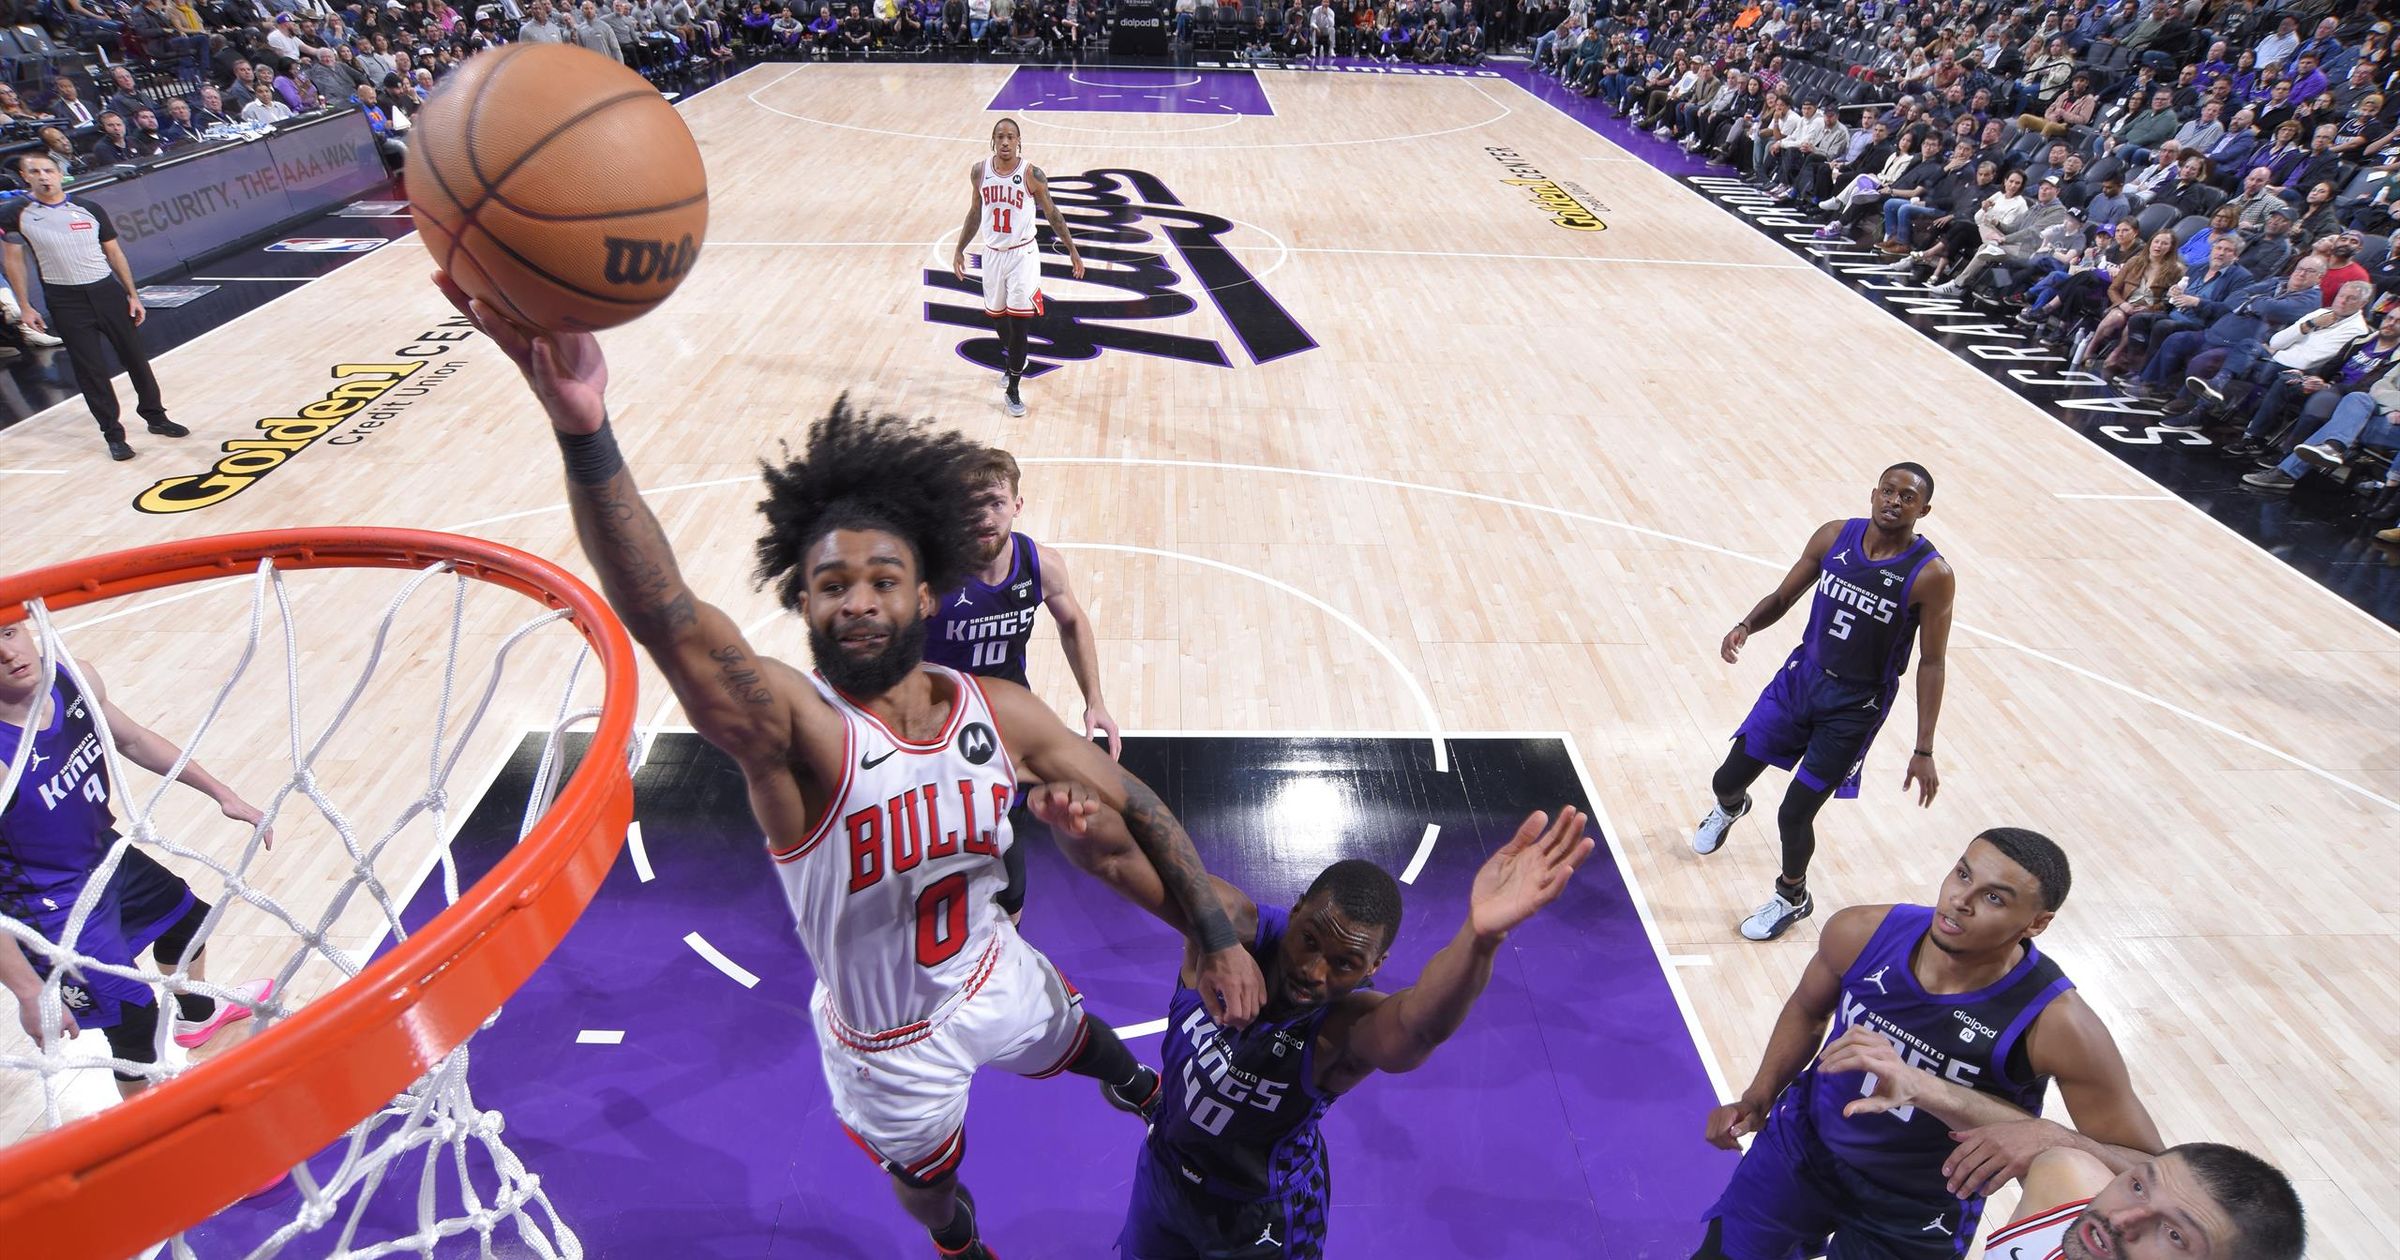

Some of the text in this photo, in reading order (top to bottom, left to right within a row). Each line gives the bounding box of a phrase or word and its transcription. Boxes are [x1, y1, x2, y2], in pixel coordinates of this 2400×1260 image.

[1120, 18, 1150, 28] dialpad
[1484, 146, 1547, 180] CENTER
[115, 140, 358, 243] SECURITY, THE AAA WAY
[982, 185, 1024, 210] BULLS
[993, 207, 1012, 234] 11
[1687, 175, 2212, 446] SACRAMENTO PROUD
[132, 316, 475, 514] Golden1 CEN
[327, 360, 469, 446] Credit Union
[1011, 579, 1033, 591] dialpad
[1836, 577, 1879, 600] SACRAMENTO
[1880, 569, 1904, 582] dialpad
[970, 611, 1018, 625] SACRAMENTO
[1828, 608, 1856, 640] 5
[972, 641, 1009, 667] 10
[38, 738, 103, 811] KING
[83, 772, 107, 803] 9
[915, 871, 969, 968] 0
[1868, 1011, 1945, 1061] SACRAMENTO
[1953, 1009, 1997, 1039] dialpad
[1183, 1058, 1235, 1136] 40
